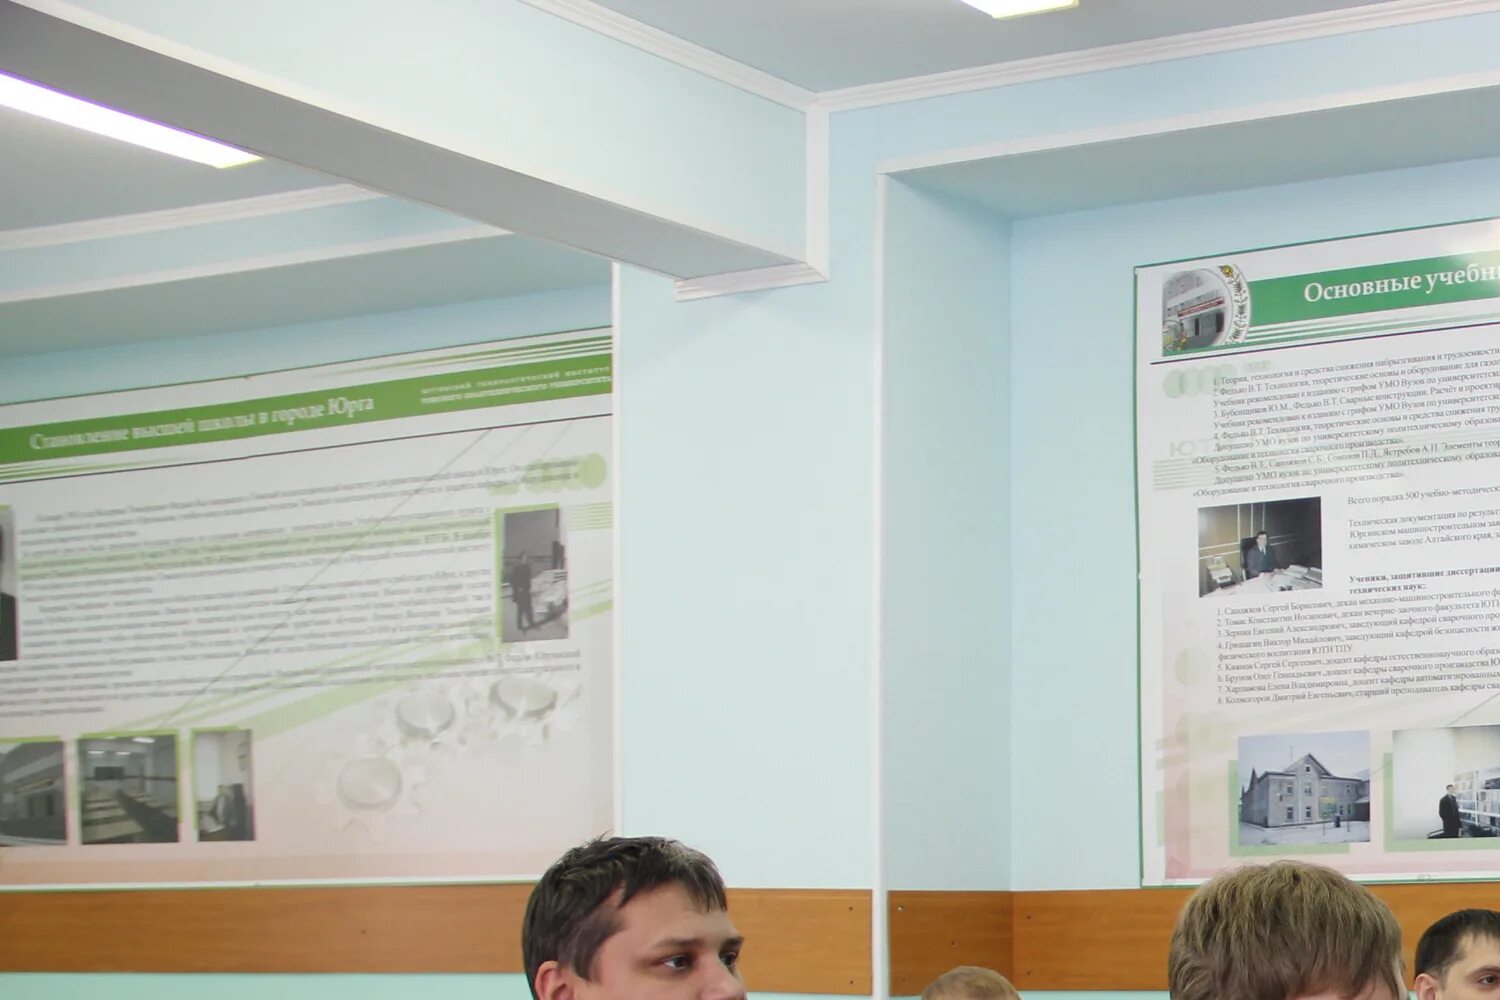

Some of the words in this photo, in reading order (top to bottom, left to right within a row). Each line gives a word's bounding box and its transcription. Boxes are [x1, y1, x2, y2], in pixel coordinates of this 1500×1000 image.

[1304, 275, 1420, 303] Основные
[1335, 361, 1373, 371] снижения
[1375, 354, 1435, 367] набрызгивания
[1444, 347, 1499, 361] трудоемкости
[1370, 369, 1399, 378] основы
[1407, 363, 1462, 375] оборудование
[1464, 361, 1478, 369] для
[1347, 382, 1376, 394] грифом
[1378, 379, 1399, 388] УМО
[1401, 378, 1424, 388] Вузов
[1430, 385, 1456, 395] Расчёт
[327, 396, 375, 418] Юрга
[1372, 414, 1401, 423] основы
[1445, 406, 1485, 416] снижения
[1313, 428, 1384, 443] университетскому
[1386, 420, 1461, 433] политехническому
[1382, 446, 1420, 457] Ястребов
[1443, 441, 1483, 450] Элементы
[1347, 496, 1370, 504] Всего
[1405, 490, 1419, 499] 500
[1473, 532, 1493, 541] края,
[1349, 574, 1388, 583] Ученики,
[1390, 570, 1444, 580] защитившие
[1446, 566, 1500, 577] диссертации
[1349, 585, 1401, 594] технических
[1349, 617, 1397, 629] заведующий
[1399, 615, 1437, 626] кафедрой
[1438, 613, 1483, 624] сварочного
[1345, 630, 1393, 642] заведующий
[1395, 627, 1433, 639] кафедрой
[1434, 625, 1489, 635] безопасности
[1266, 648, 1310, 657] воспитания
[1312, 645, 1333, 654] ЮТИ
[1335, 643, 1352, 651] ТПУ
[1353, 654, 1387, 664] кафедры
[1353, 665, 1386, 676] кафедры
[1388, 663, 1433, 673] сварочного
[1434, 660, 1488, 671] производства
[1450, 683, 1485, 693] кафедры
